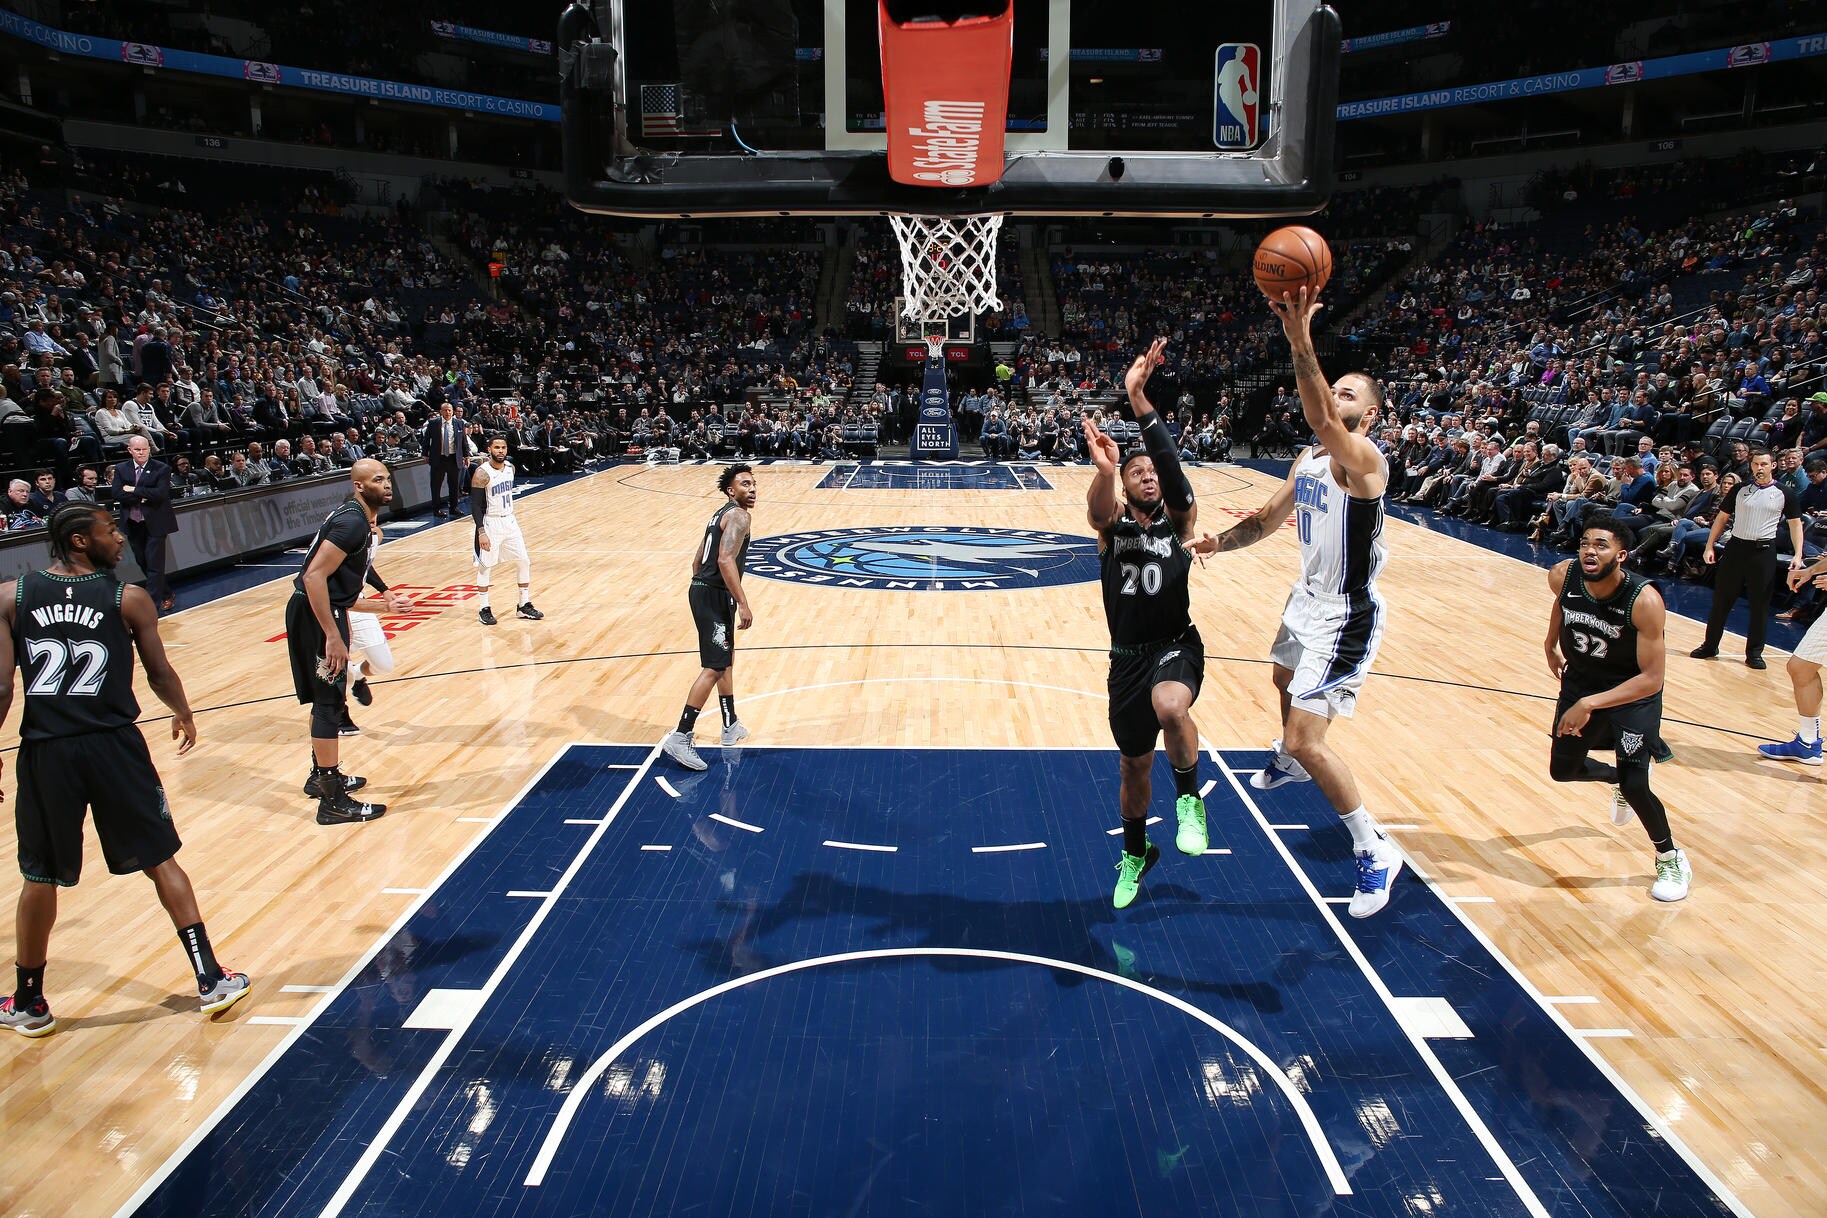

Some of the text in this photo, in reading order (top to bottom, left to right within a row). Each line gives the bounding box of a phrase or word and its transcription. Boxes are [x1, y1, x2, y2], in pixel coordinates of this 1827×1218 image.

[35, 25, 93, 53] CASINO
[300, 71, 379, 94] TREASURE
[435, 89, 483, 109] RESORT
[485, 98, 495, 110] &
[497, 99, 544, 117] CASINO
[1401, 92, 1451, 110] ISLAND
[1454, 83, 1507, 103] RESORT
[1509, 81, 1520, 96] &
[1523, 73, 1581, 94] CASINO
[1220, 125, 1241, 142] NBA
[921, 440, 951, 448] NORTH
[1120, 561, 1163, 596] 20
[31, 603, 104, 629] WIGGINS
[1561, 605, 1624, 639] TIMBERWOLVES
[1571, 629, 1608, 659] 32
[25, 637, 109, 697] 22
